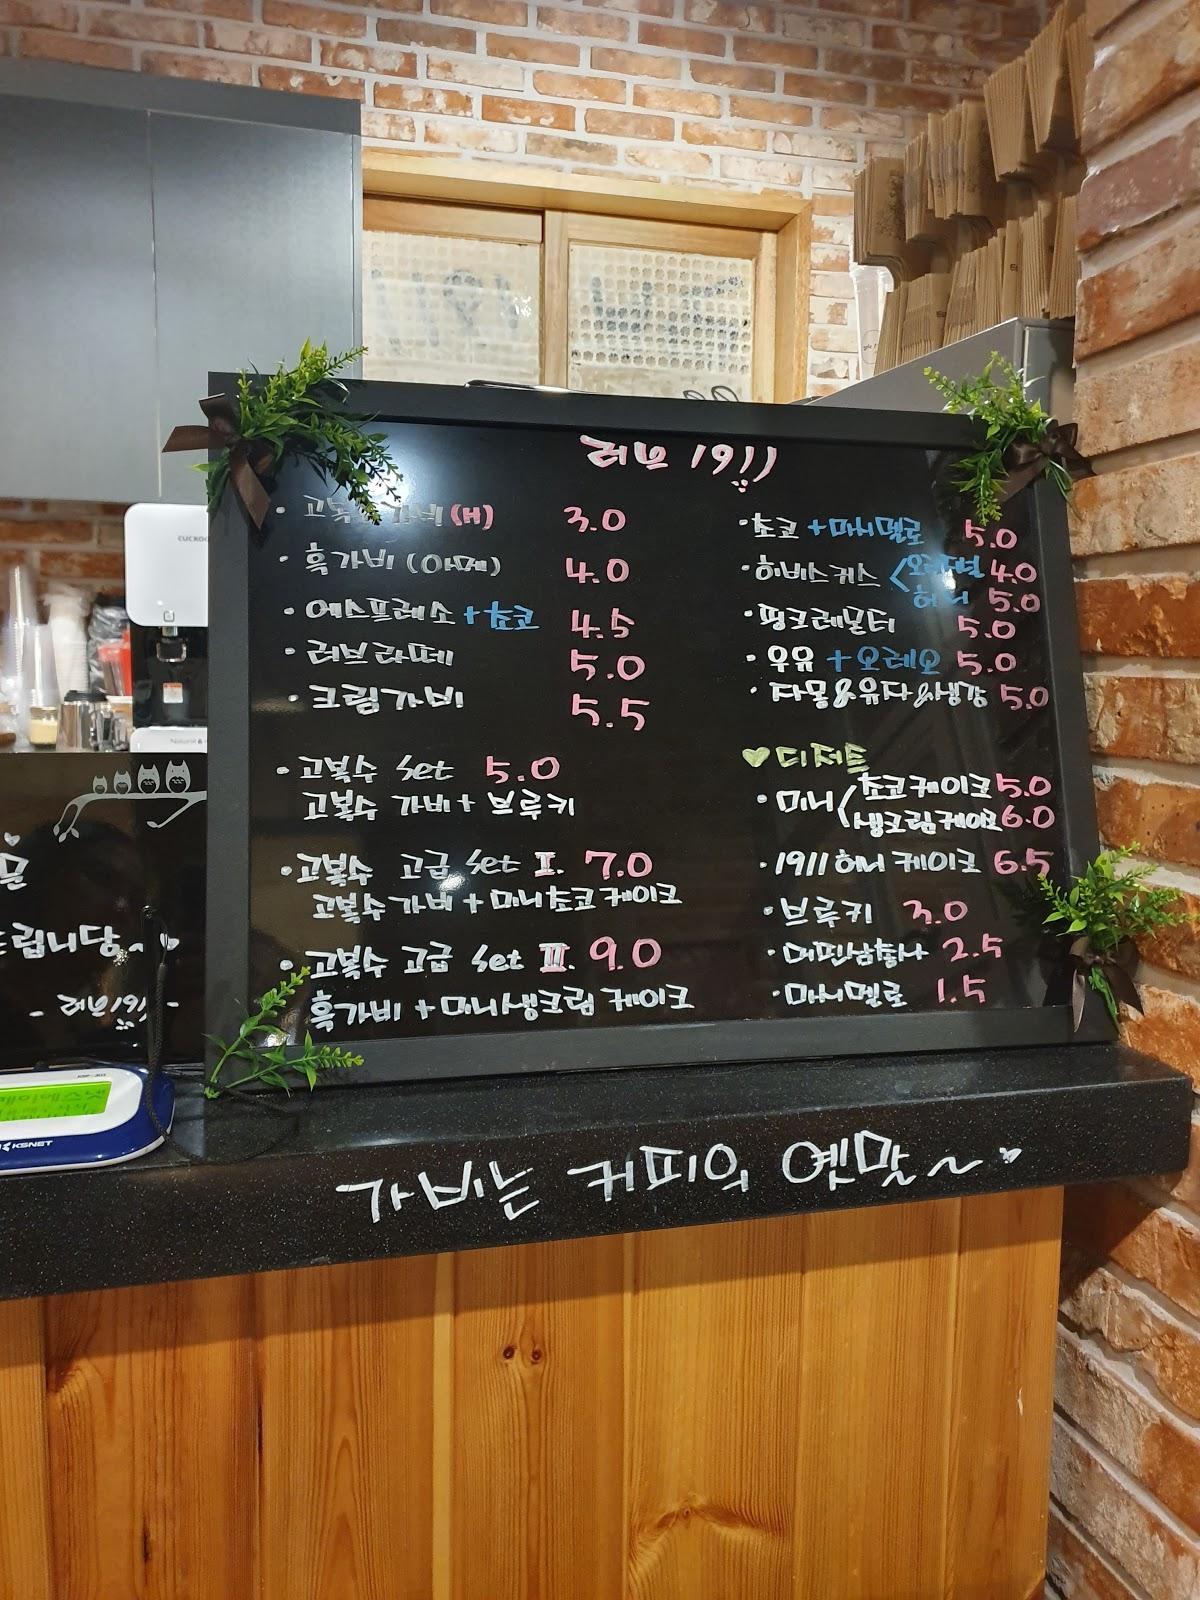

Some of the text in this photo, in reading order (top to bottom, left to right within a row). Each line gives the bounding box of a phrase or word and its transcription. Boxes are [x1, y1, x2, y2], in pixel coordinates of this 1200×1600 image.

[580, 434, 778, 483] 러브 1911
[450, 504, 494, 530] (H)
[563, 506, 626, 533] 3.0
[751, 512, 800, 538] 초코
[965, 519, 1018, 549] 5.0
[305, 542, 630, 584] 흑가비 (아메) 4.0
[755, 554, 881, 587] 히비스커스
[990, 559, 1037, 584] 4.0
[989, 587, 1041, 613] 5.0
[305, 598, 456, 624] 에스프레소
[571, 608, 635, 639] 4.5
[758, 603, 1016, 640] 핑크레몬티 5.0
[570, 649, 646, 681] 5.0
[767, 645, 815, 673] 우유
[957, 650, 1017, 676] 5.0
[309, 684, 650, 731] 크림가비 5.5
[1000, 683, 1049, 711] 5.0
[298, 755, 378, 784] 고복수
[486, 756, 560, 784] 5.0
[775, 742, 870, 774] 디저트
[996, 773, 1052, 798] 5.0
[302, 789, 379, 821] 고복수
[487, 788, 575, 820] 브루키
[775, 789, 835, 813] 미니
[1001, 804, 1056, 829] 6.0
[296, 853, 373, 887] 고복수
[400, 849, 451, 880] 고급
[585, 850, 653, 880] 7.0
[891, 848, 983, 873] 케이크
[993, 848, 1054, 877] 6.5
[312, 892, 386, 924] 고복수
[387, 890, 454, 915] 가비
[780, 896, 969, 928] 브루키 3.0
[304, 945, 389, 980] 고복수
[401, 941, 454, 974] 고급
[589, 936, 662, 971] 9.0
[942, 933, 1004, 963] 2.5
[937, 974, 987, 1004] 1.5
[310, 990, 401, 1032] 흑가비
[12, 1140, 54, 1149] KSNET
[335, 1160, 541, 1224] 가비는
[567, 1145, 749, 1202] 커피의
